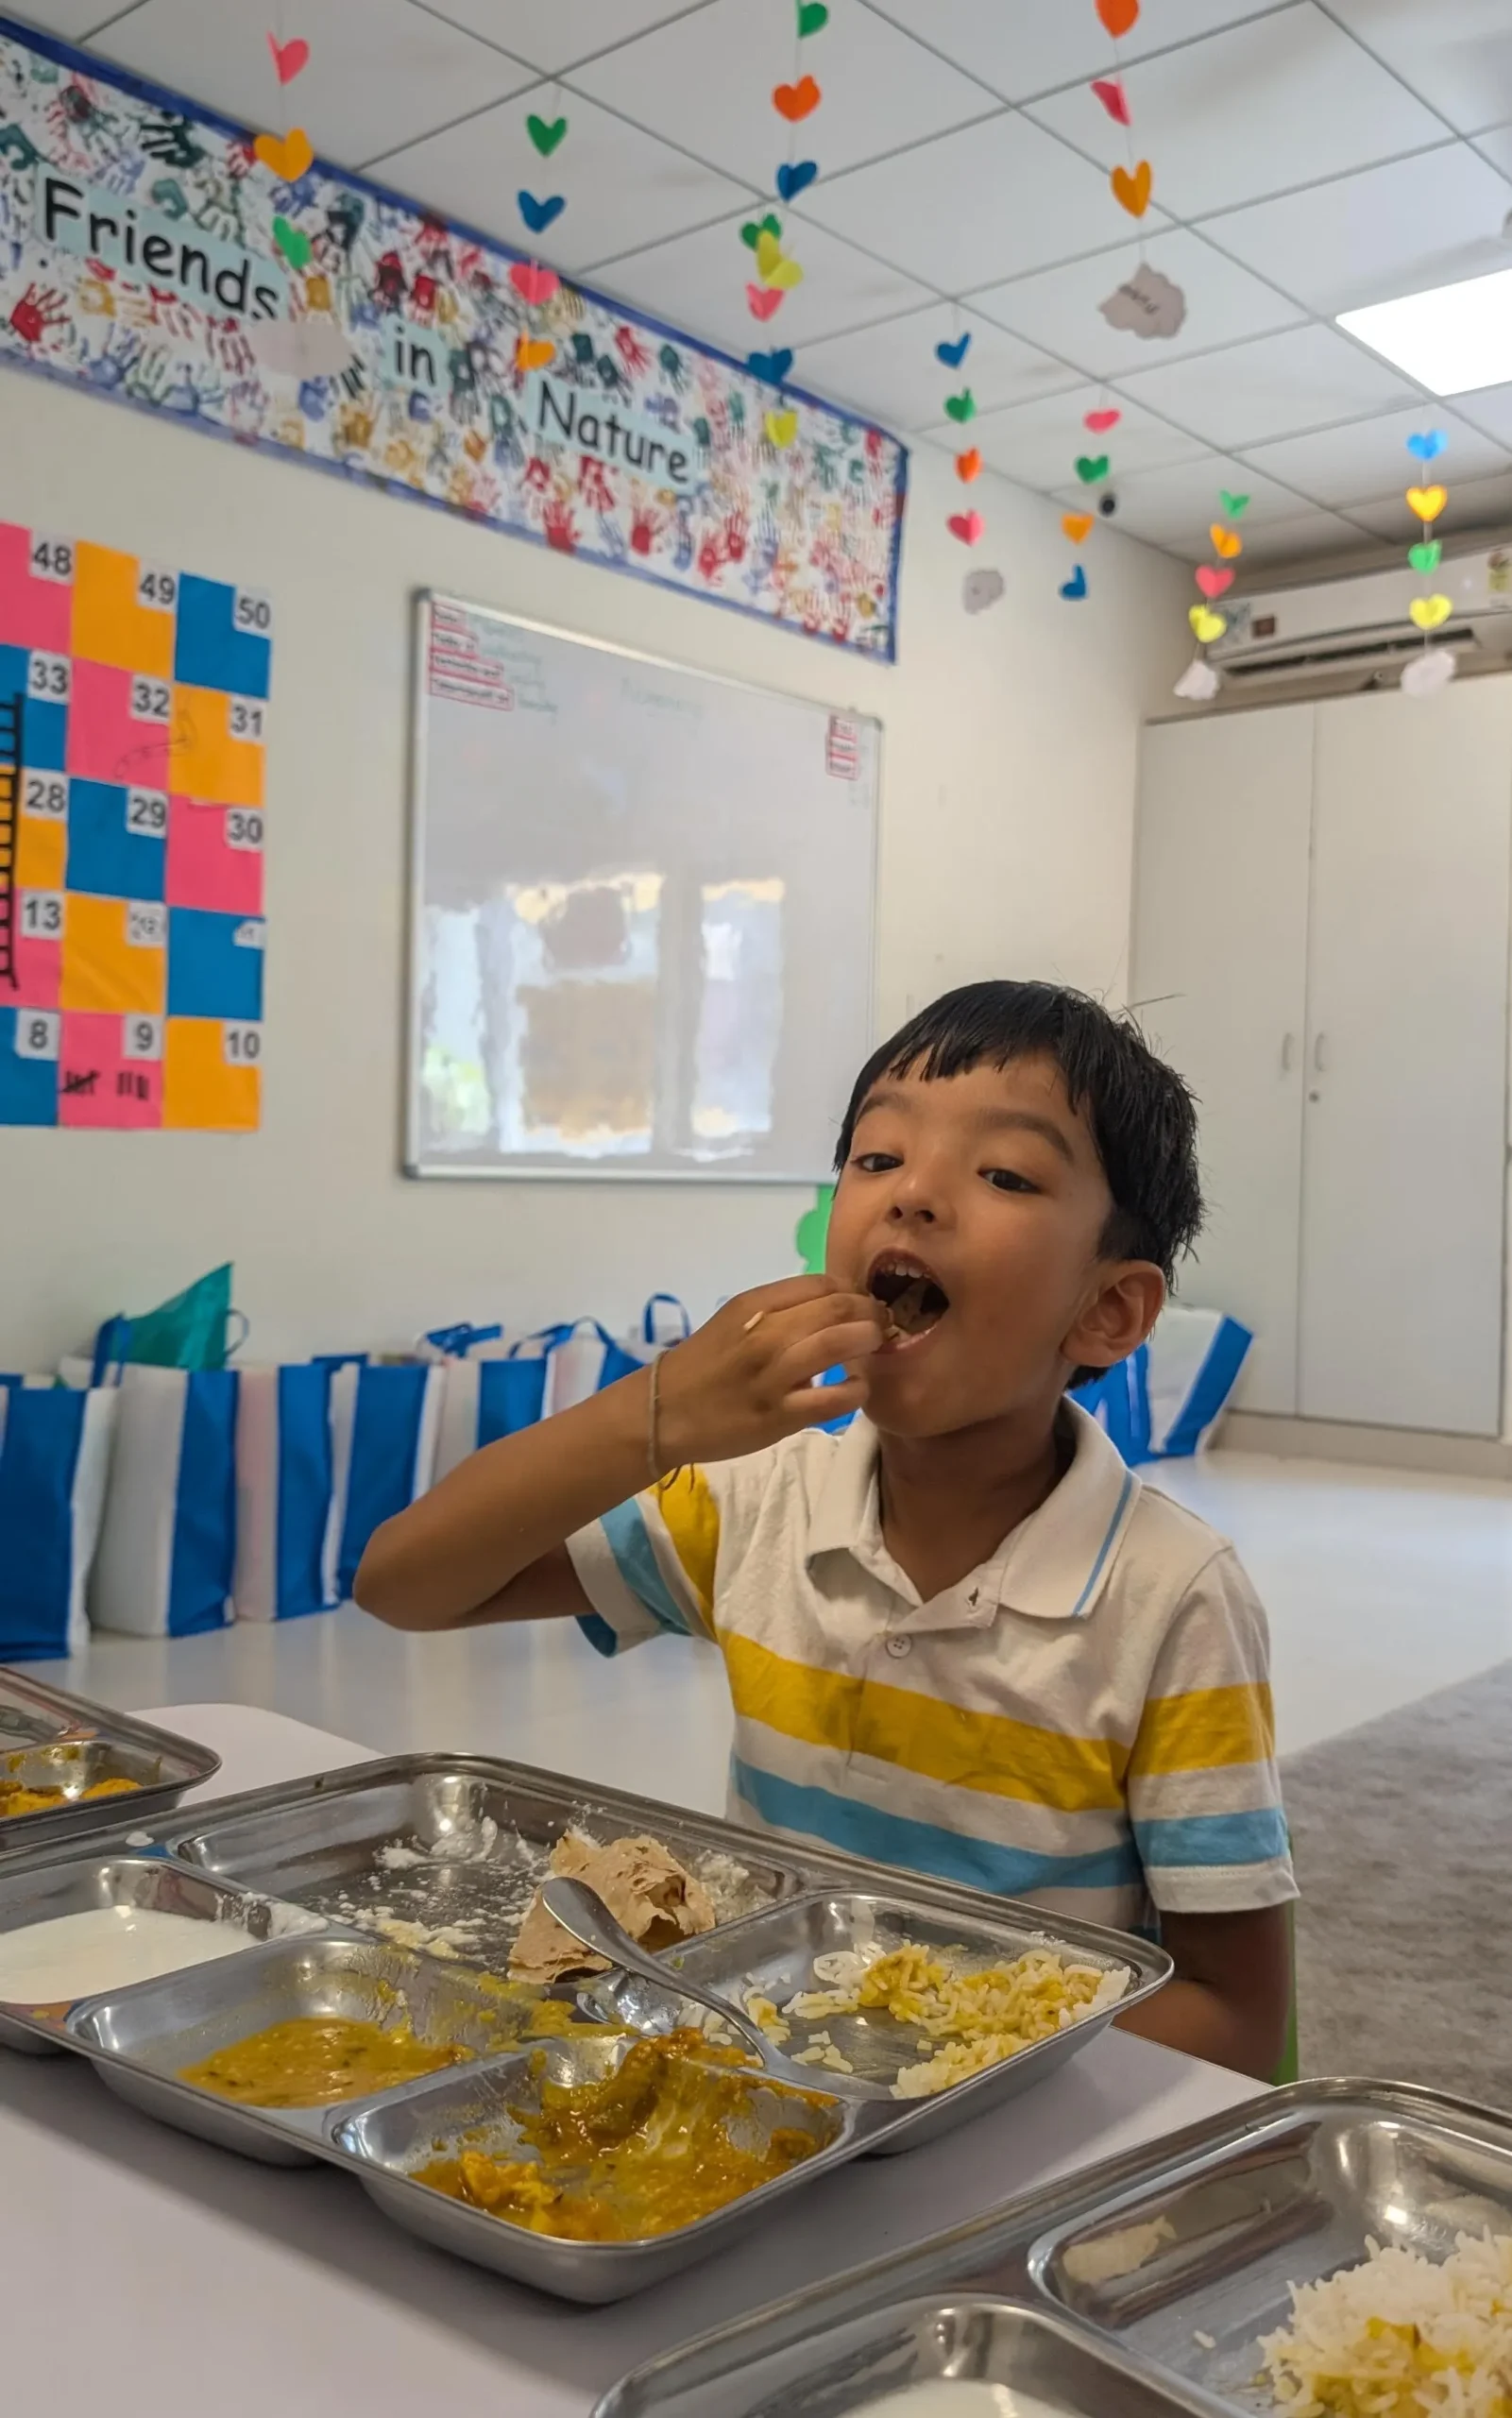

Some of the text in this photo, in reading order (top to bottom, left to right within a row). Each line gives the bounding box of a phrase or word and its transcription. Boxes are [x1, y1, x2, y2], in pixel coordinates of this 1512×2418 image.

[43, 176, 690, 484] Friends in Nature
[32, 541, 73, 577] 48
[140, 571, 176, 605] 49
[235, 596, 272, 630] 50
[31, 657, 69, 695] 33
[133, 682, 171, 718] 32
[230, 704, 263, 737] 31
[25, 778, 66, 814] 28
[130, 794, 167, 829] 29
[228, 811, 263, 844] 30
[25, 898, 61, 931] 13
[27, 1018, 48, 1050] 8
[135, 1021, 154, 1051] 9
[227, 1030, 261, 1059] 10
